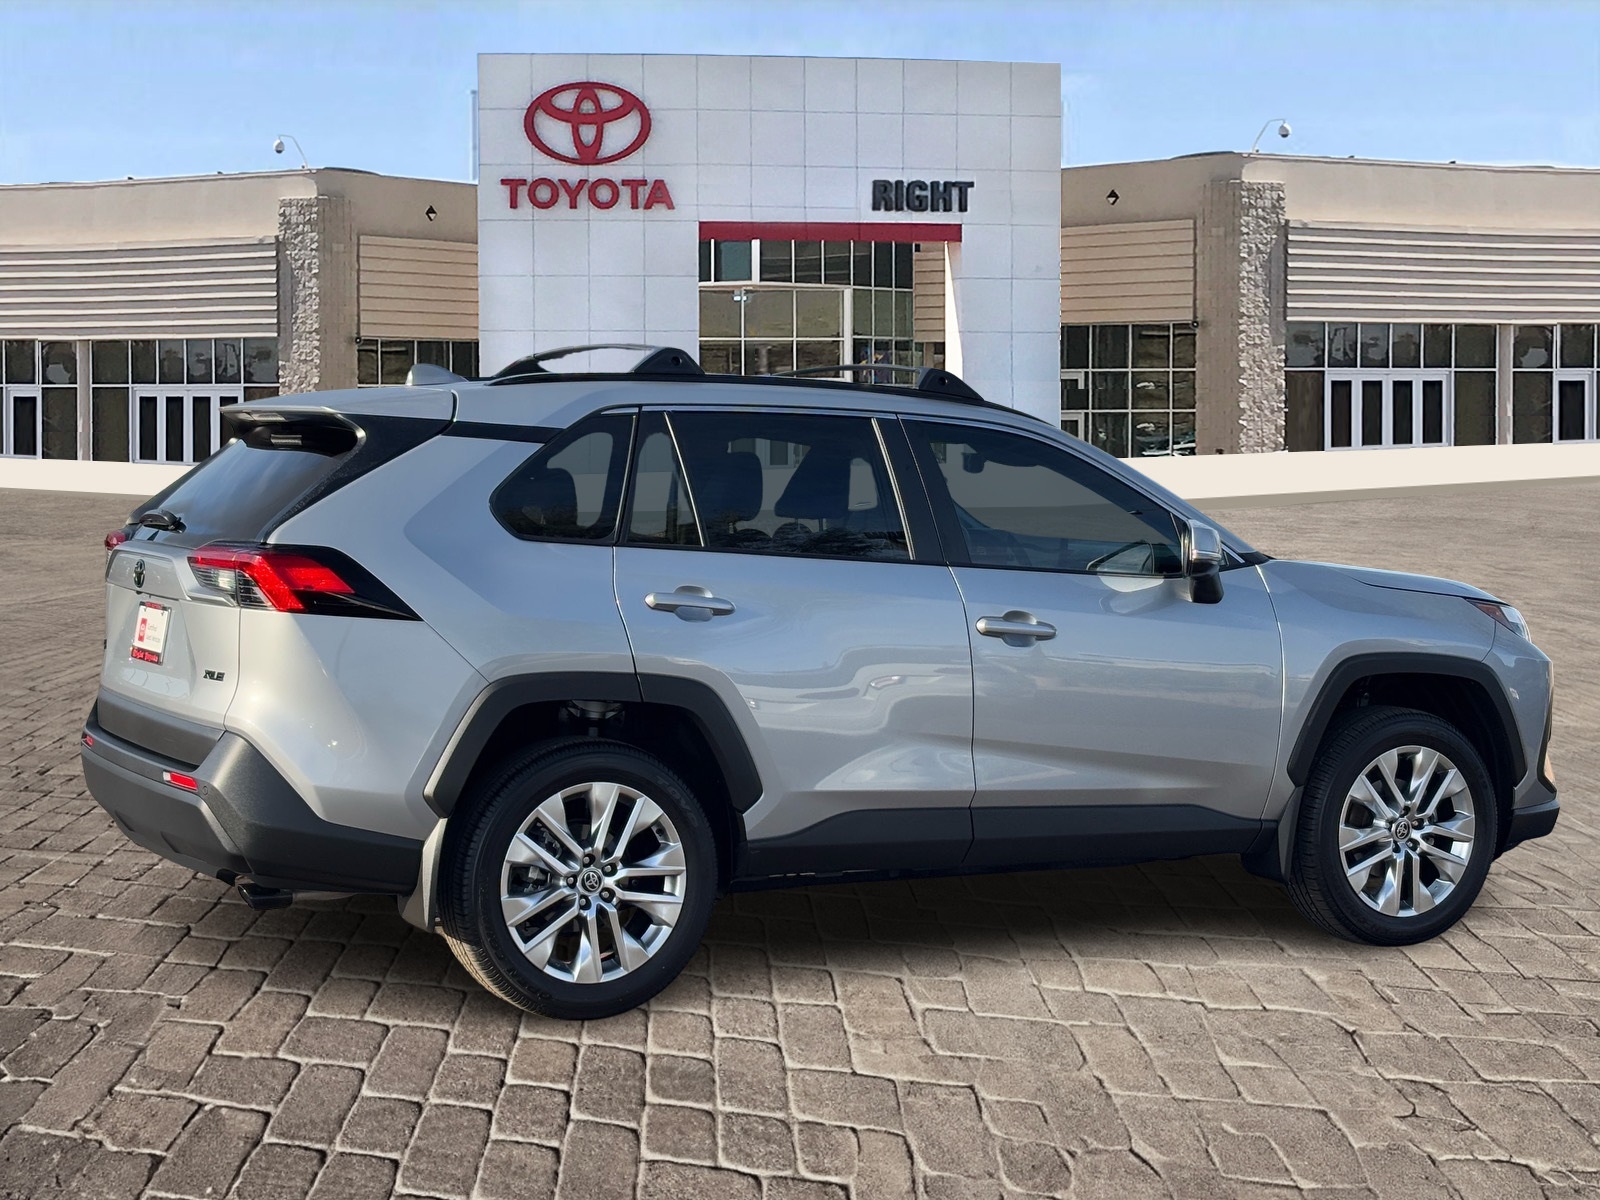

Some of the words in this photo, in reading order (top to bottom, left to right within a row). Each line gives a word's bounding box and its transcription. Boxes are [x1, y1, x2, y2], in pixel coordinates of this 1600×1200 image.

[501, 178, 675, 210] TOYOTA
[871, 180, 974, 212] RIGHT
[203, 670, 225, 681] XLE
